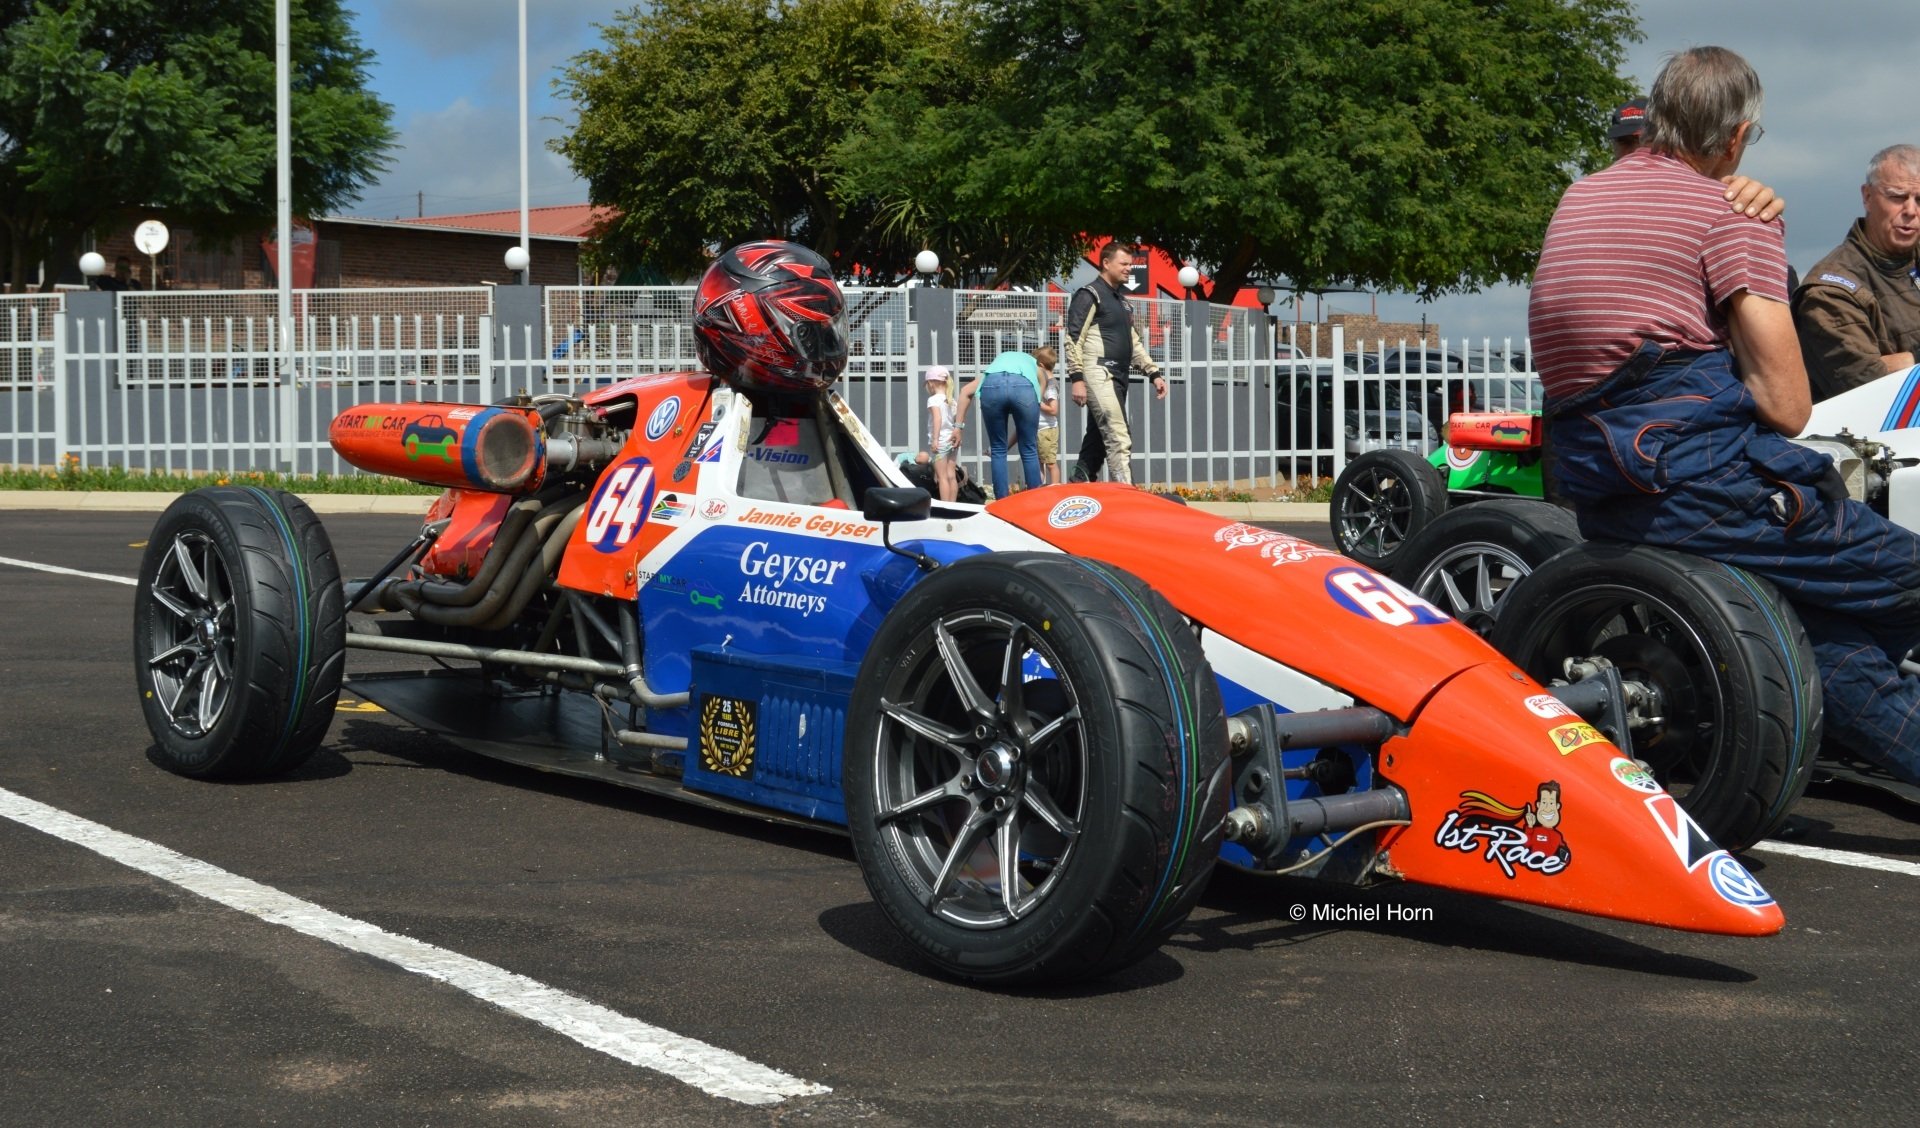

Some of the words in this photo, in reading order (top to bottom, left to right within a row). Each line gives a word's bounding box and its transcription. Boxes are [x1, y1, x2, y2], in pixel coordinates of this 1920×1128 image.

[585, 466, 655, 545] 64
[738, 507, 802, 528] Jannie
[805, 515, 880, 538] Geyser
[1053, 499, 1077, 517] SPORTS
[740, 541, 847, 588] Geyser
[738, 581, 828, 618] Attorneys
[722, 700, 732, 713] 25
[714, 727, 740, 738] LIBRE
[1437, 812, 1498, 851] 1st
[1487, 826, 1566, 877] Race
